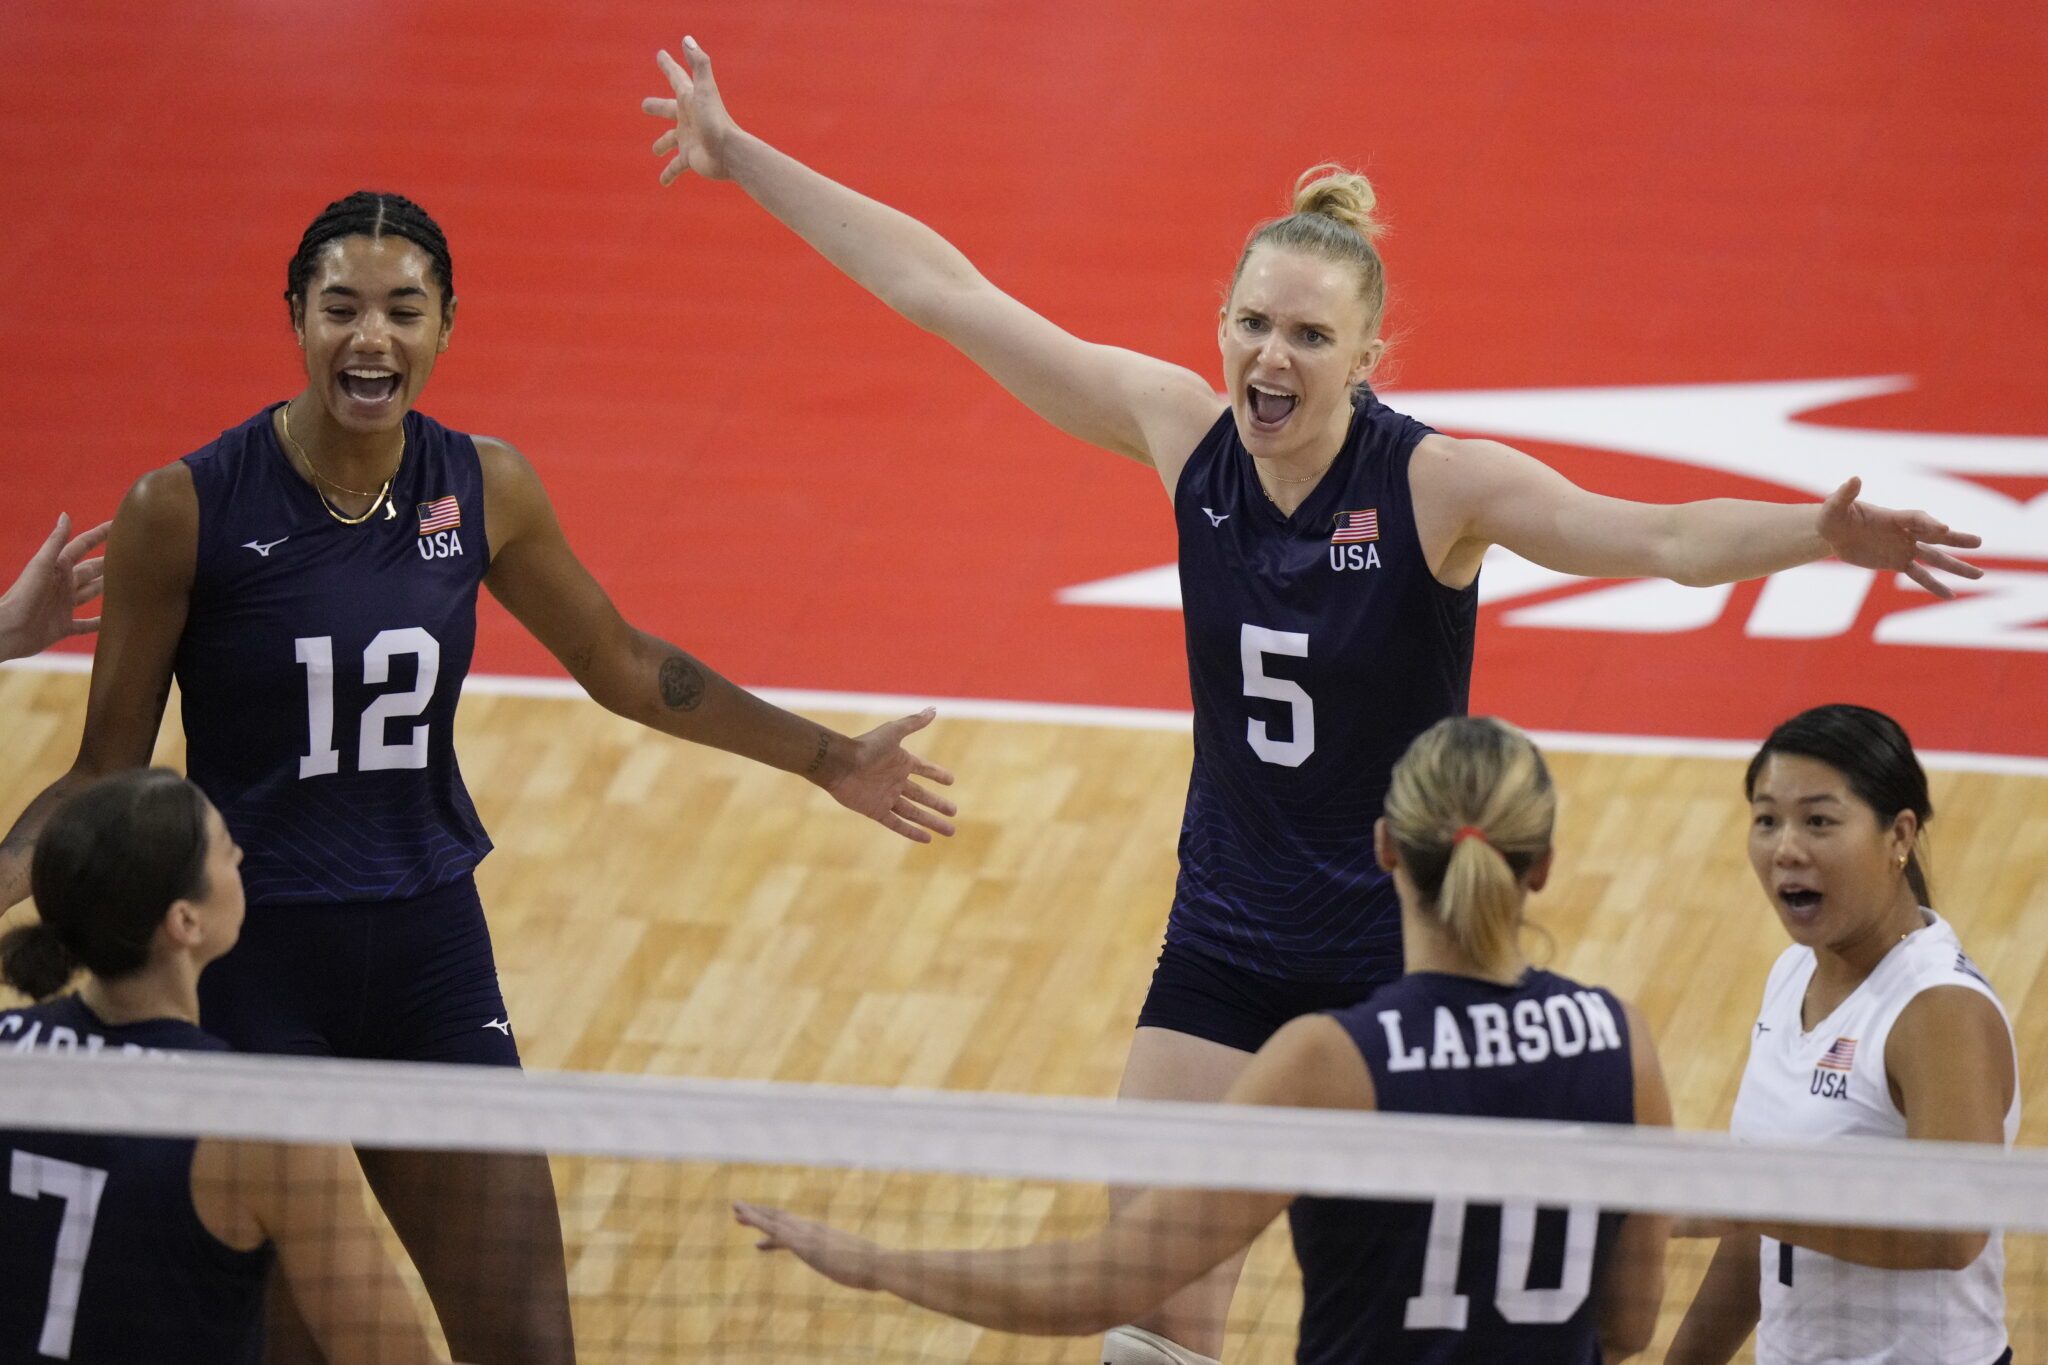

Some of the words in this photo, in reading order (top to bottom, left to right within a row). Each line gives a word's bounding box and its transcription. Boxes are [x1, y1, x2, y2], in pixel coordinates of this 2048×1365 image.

[417, 530, 463, 560] USA
[1330, 543, 1381, 571] USA
[295, 626, 440, 779] 12
[1241, 623, 1315, 767] 5
[1378, 991, 1622, 1072] LARSON
[1810, 1069, 1848, 1099] USA
[9, 1148, 109, 1360] 7
